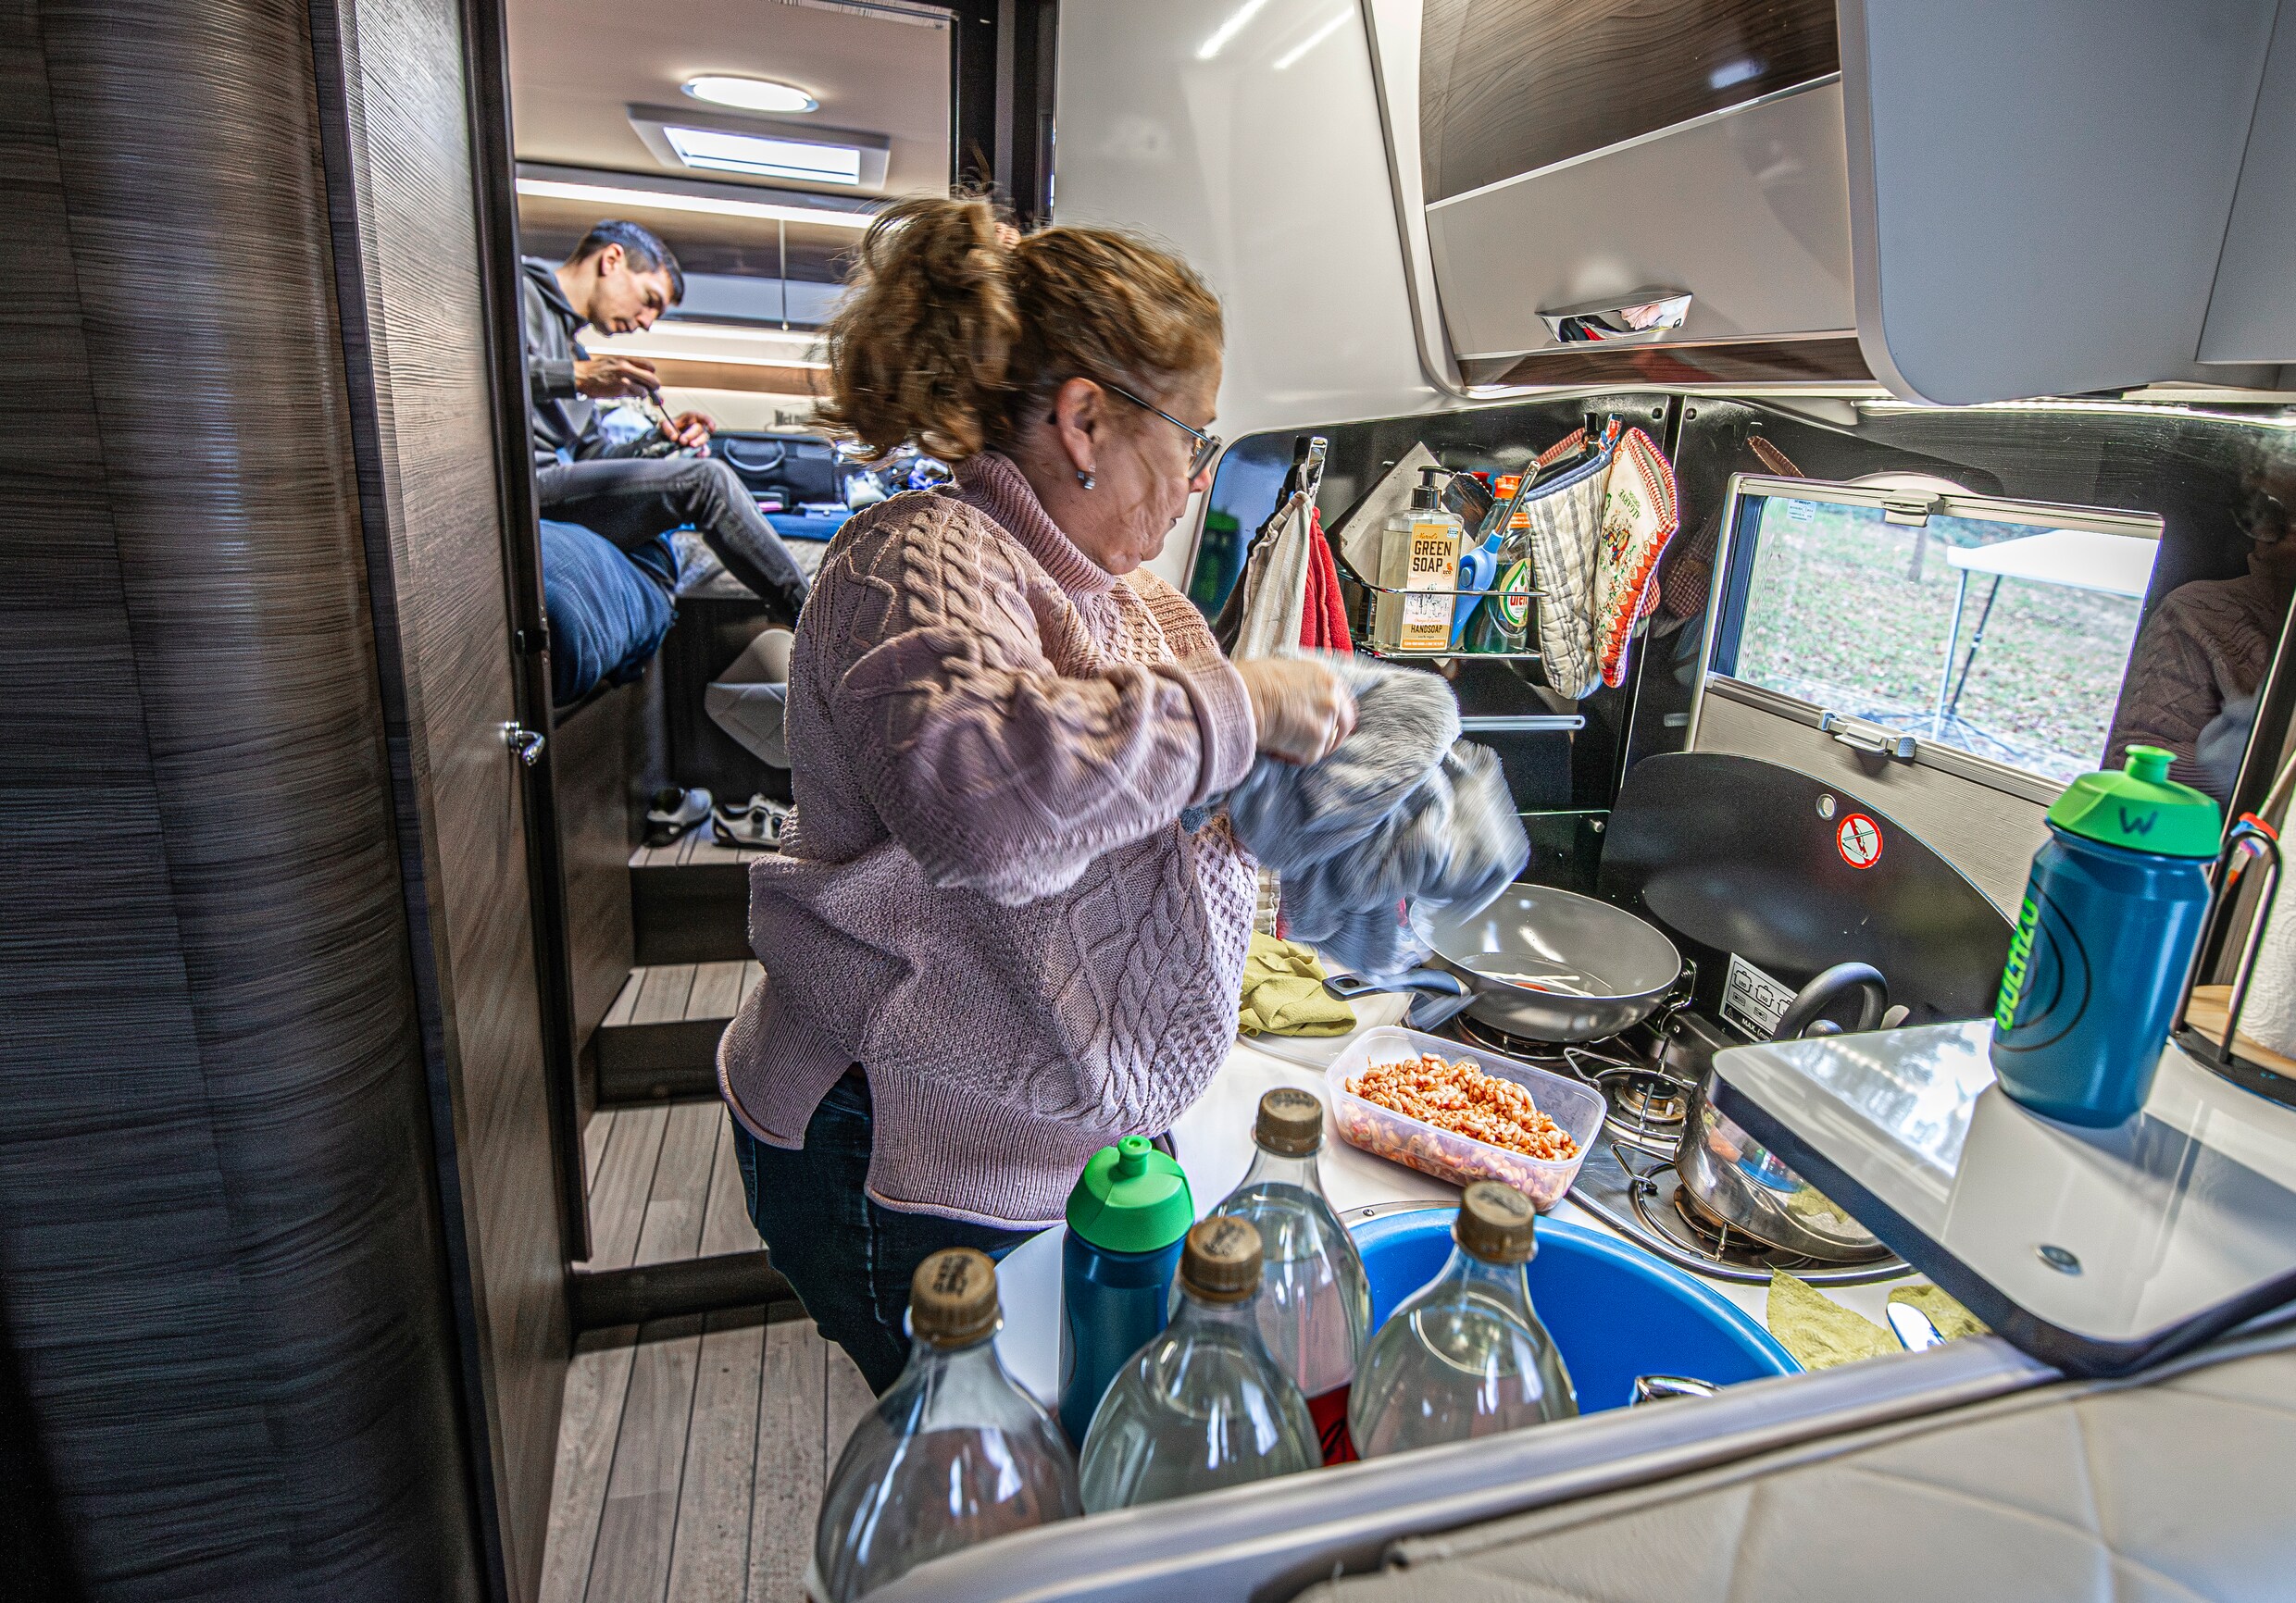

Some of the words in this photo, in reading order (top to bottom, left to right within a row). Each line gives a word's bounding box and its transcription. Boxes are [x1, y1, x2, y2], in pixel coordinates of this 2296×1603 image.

[1414, 541, 1452, 556] GREEN
[1412, 557, 1443, 573] SOAP
[1410, 624, 1442, 634] HANDSOAP
[2119, 806, 2158, 837] W
[1741, 1017, 1757, 1034] MAX.
